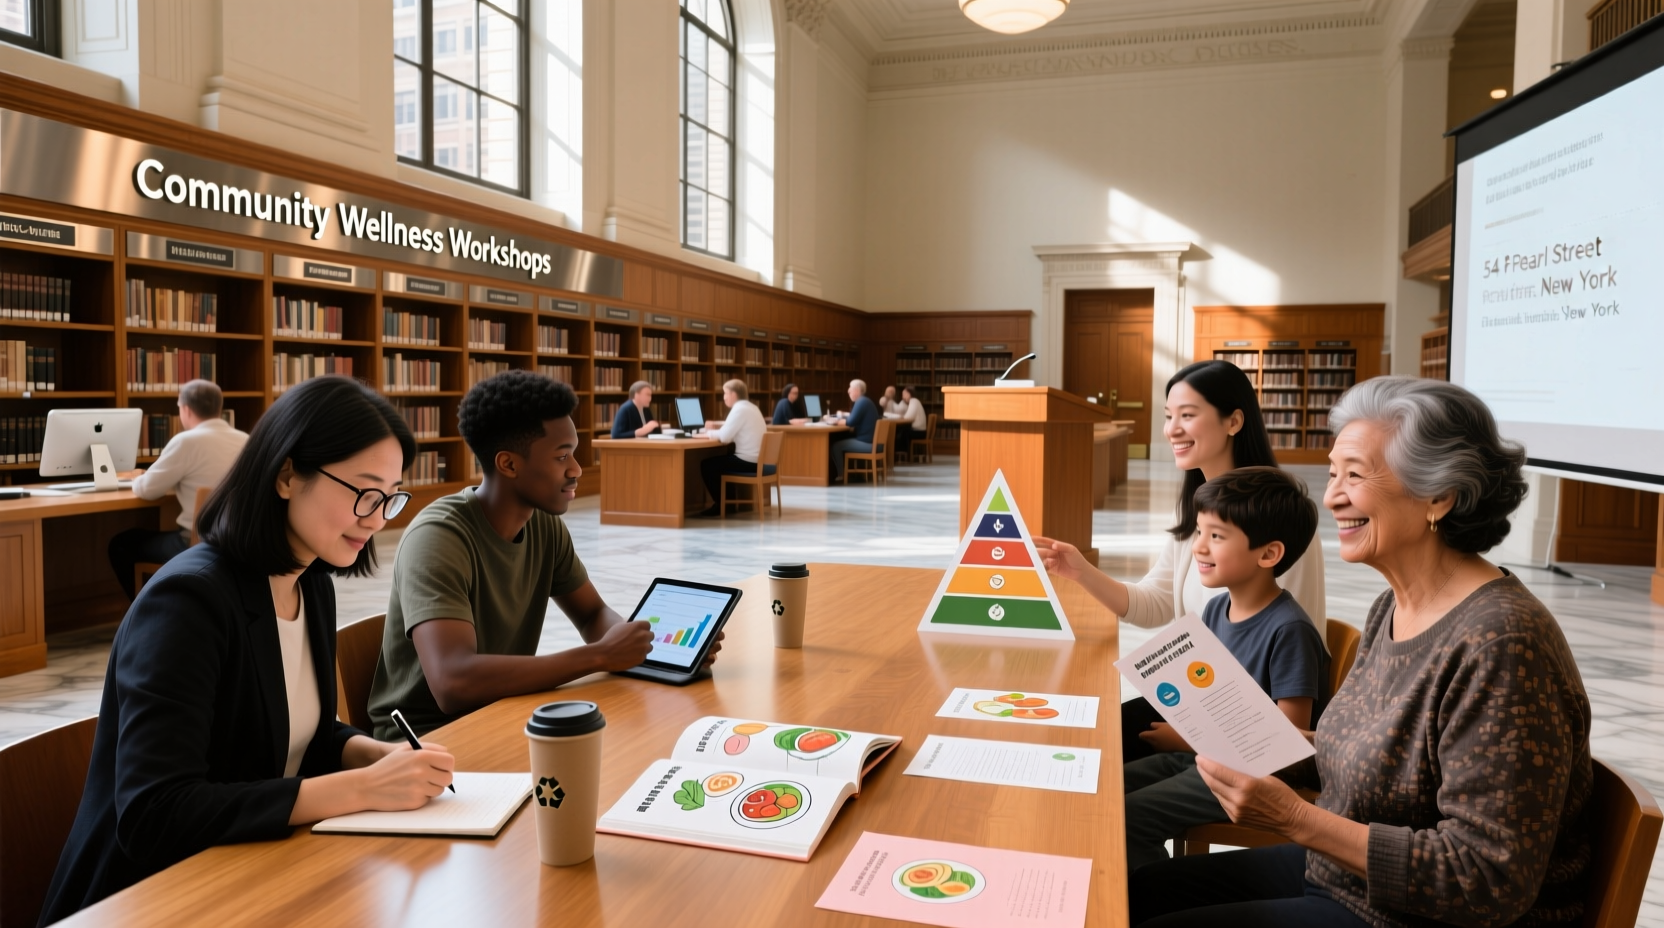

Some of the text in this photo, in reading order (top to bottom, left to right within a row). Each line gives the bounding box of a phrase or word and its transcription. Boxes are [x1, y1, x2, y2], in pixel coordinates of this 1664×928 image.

[136, 158, 552, 280] Community Wellness Workshops
[1552, 236, 1602, 264] Street
[1541, 276, 1573, 297] New
[1579, 265, 1617, 291] York
[1591, 300, 1620, 317] York
